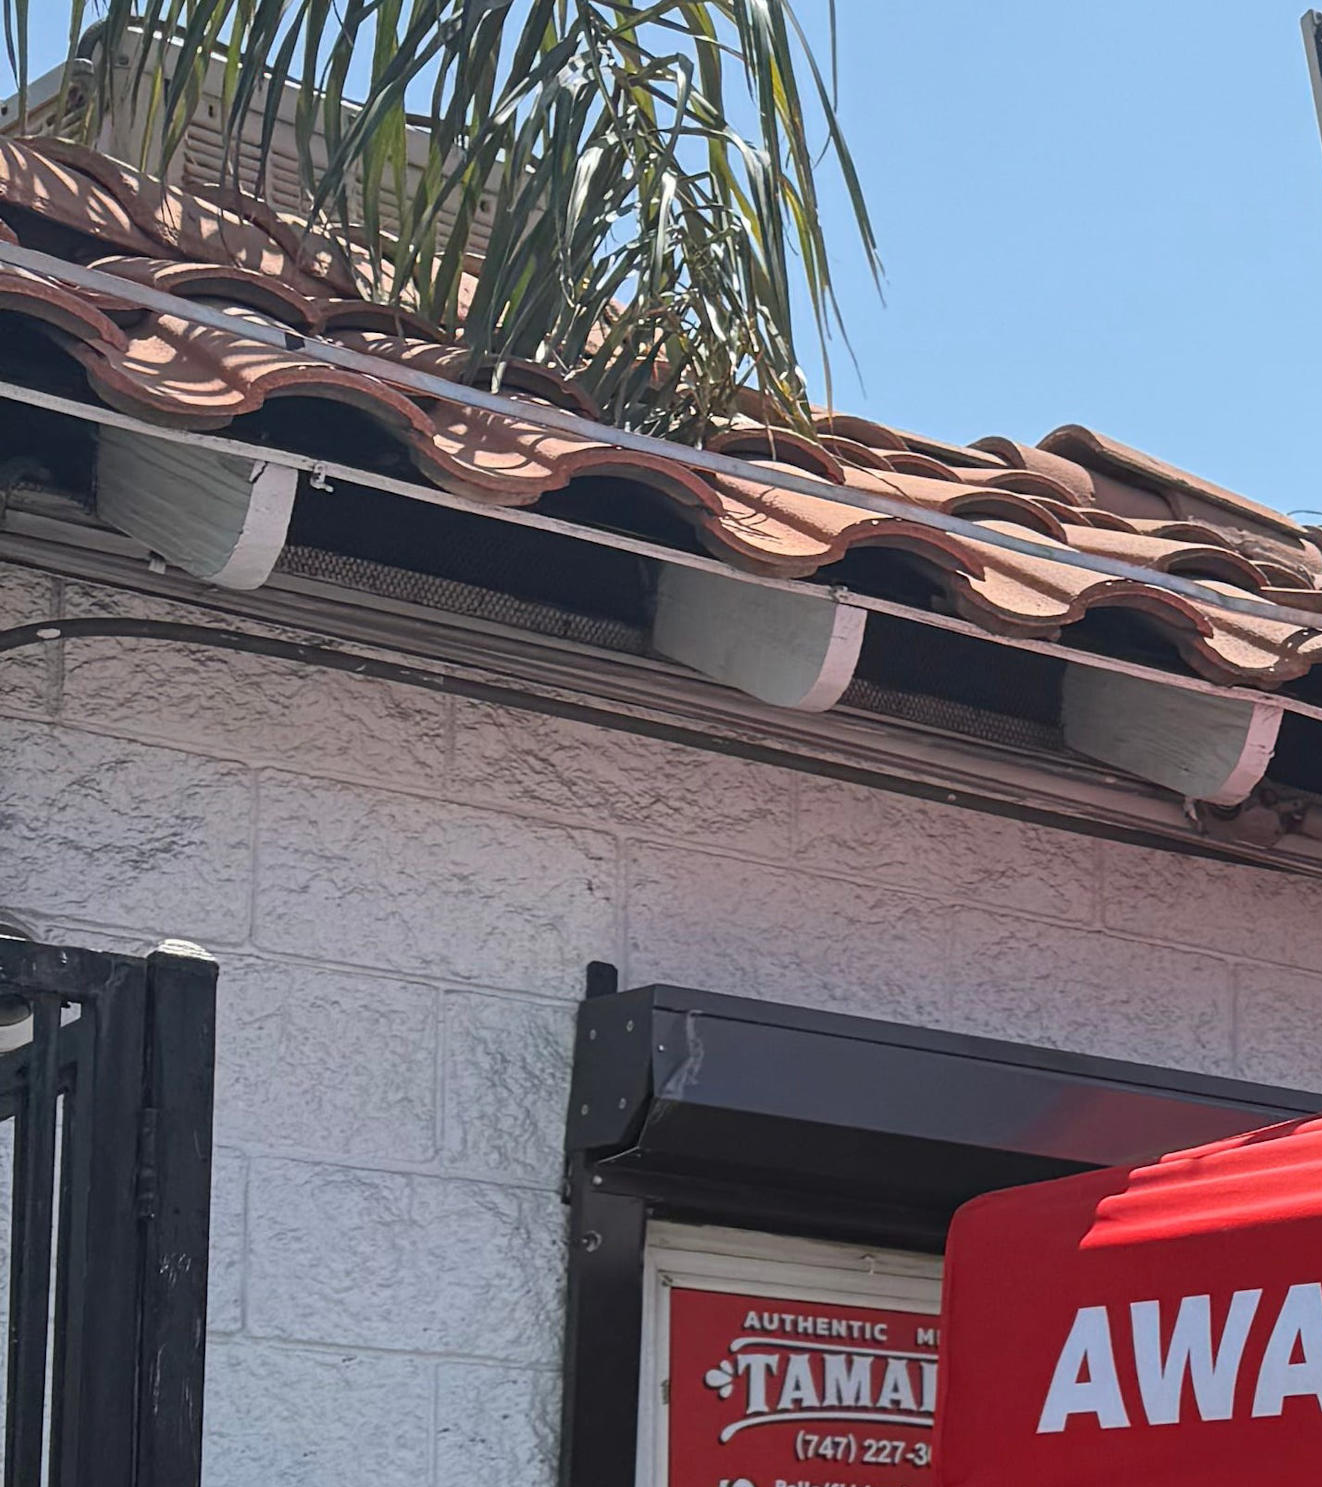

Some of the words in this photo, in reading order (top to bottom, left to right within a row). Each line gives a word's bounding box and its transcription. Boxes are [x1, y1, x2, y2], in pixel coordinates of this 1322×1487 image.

[744, 1310, 889, 1341] AUTHENTIC
[796, 1430, 856, 1464] (747)
[862, 1438, 932, 1467] 227-3
